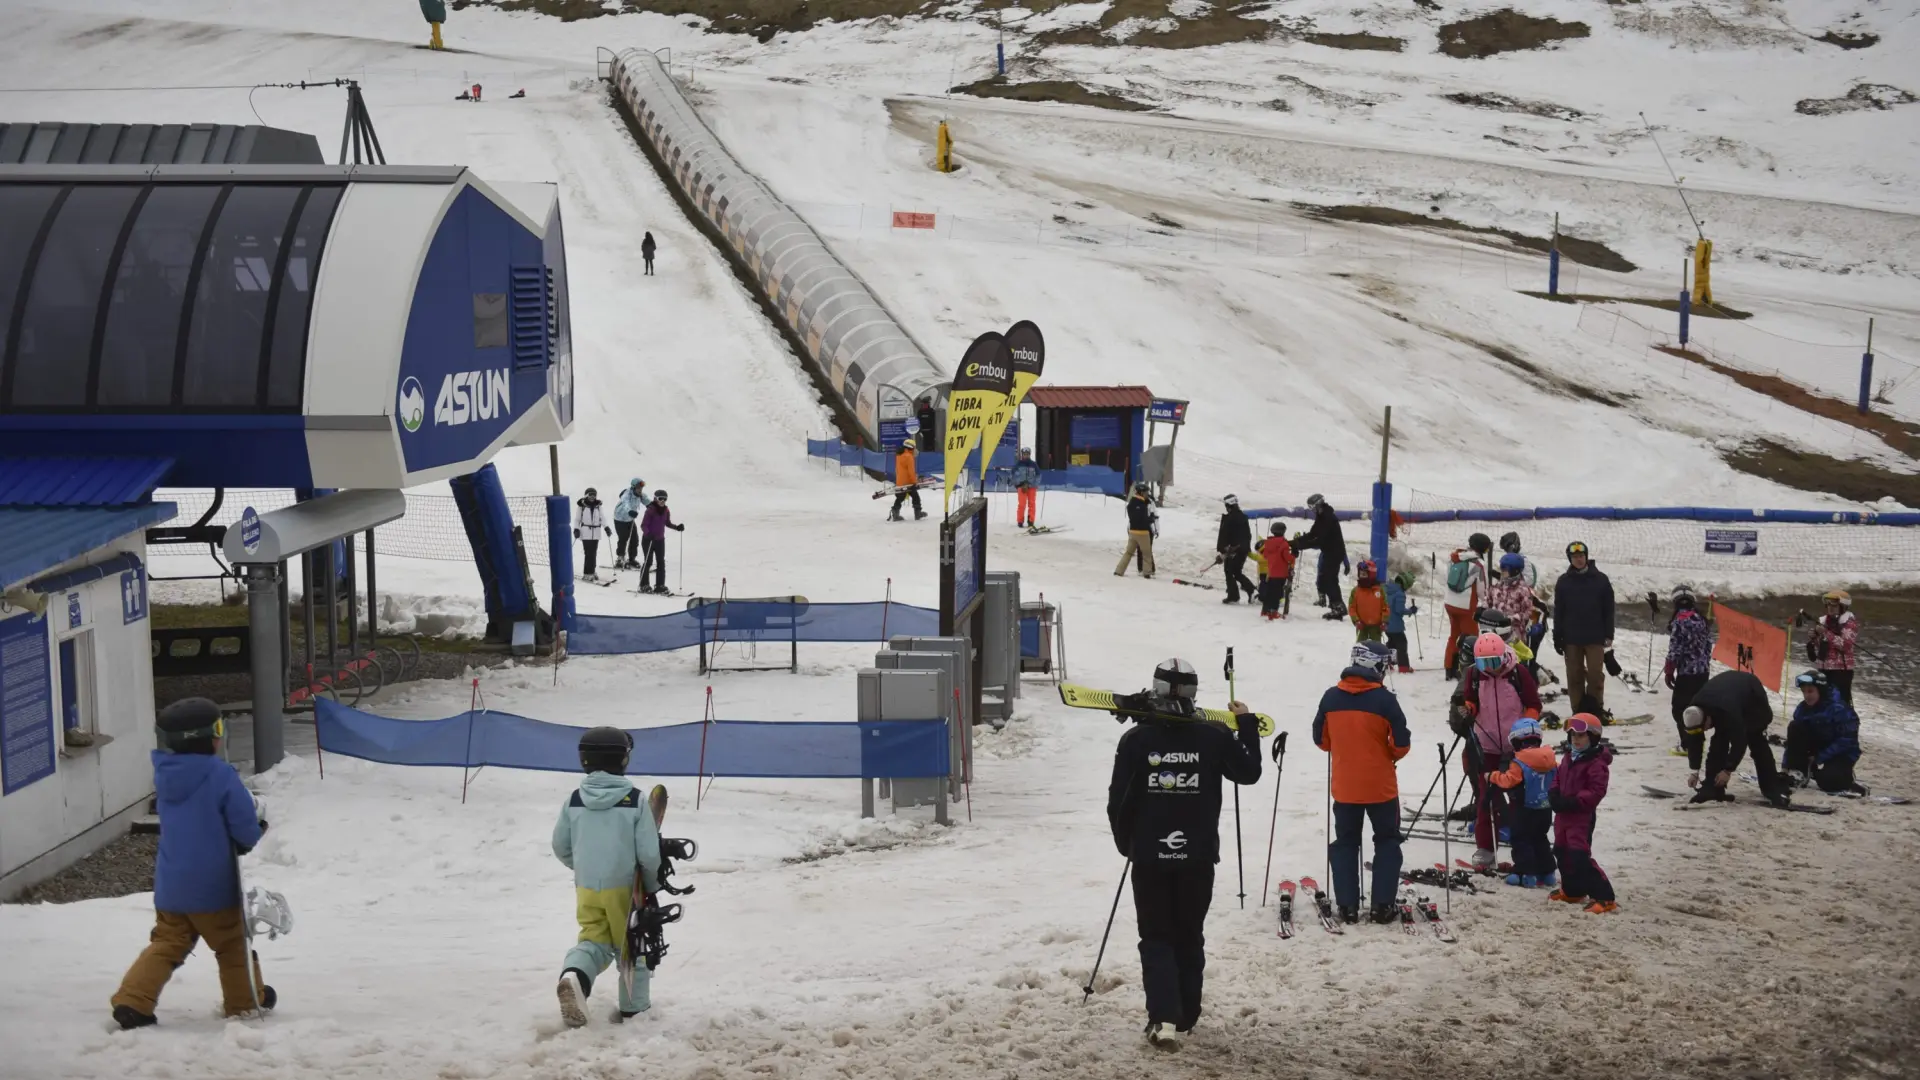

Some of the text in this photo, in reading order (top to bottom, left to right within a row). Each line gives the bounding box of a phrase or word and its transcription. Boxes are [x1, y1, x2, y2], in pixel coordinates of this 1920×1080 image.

[1011, 347, 1038, 362] mbou
[966, 361, 1007, 380] embou
[434, 368, 511, 427] ASTUN
[954, 397, 982, 411] FIBRA
[994, 412, 1004, 425] TV
[1151, 408, 1172, 418] SALIDA
[949, 414, 981, 431] MÓVIL
[948, 435, 967, 450] & TV
[1161, 752, 1200, 763] ASTUN
[1538, 773, 1546, 791] 7
